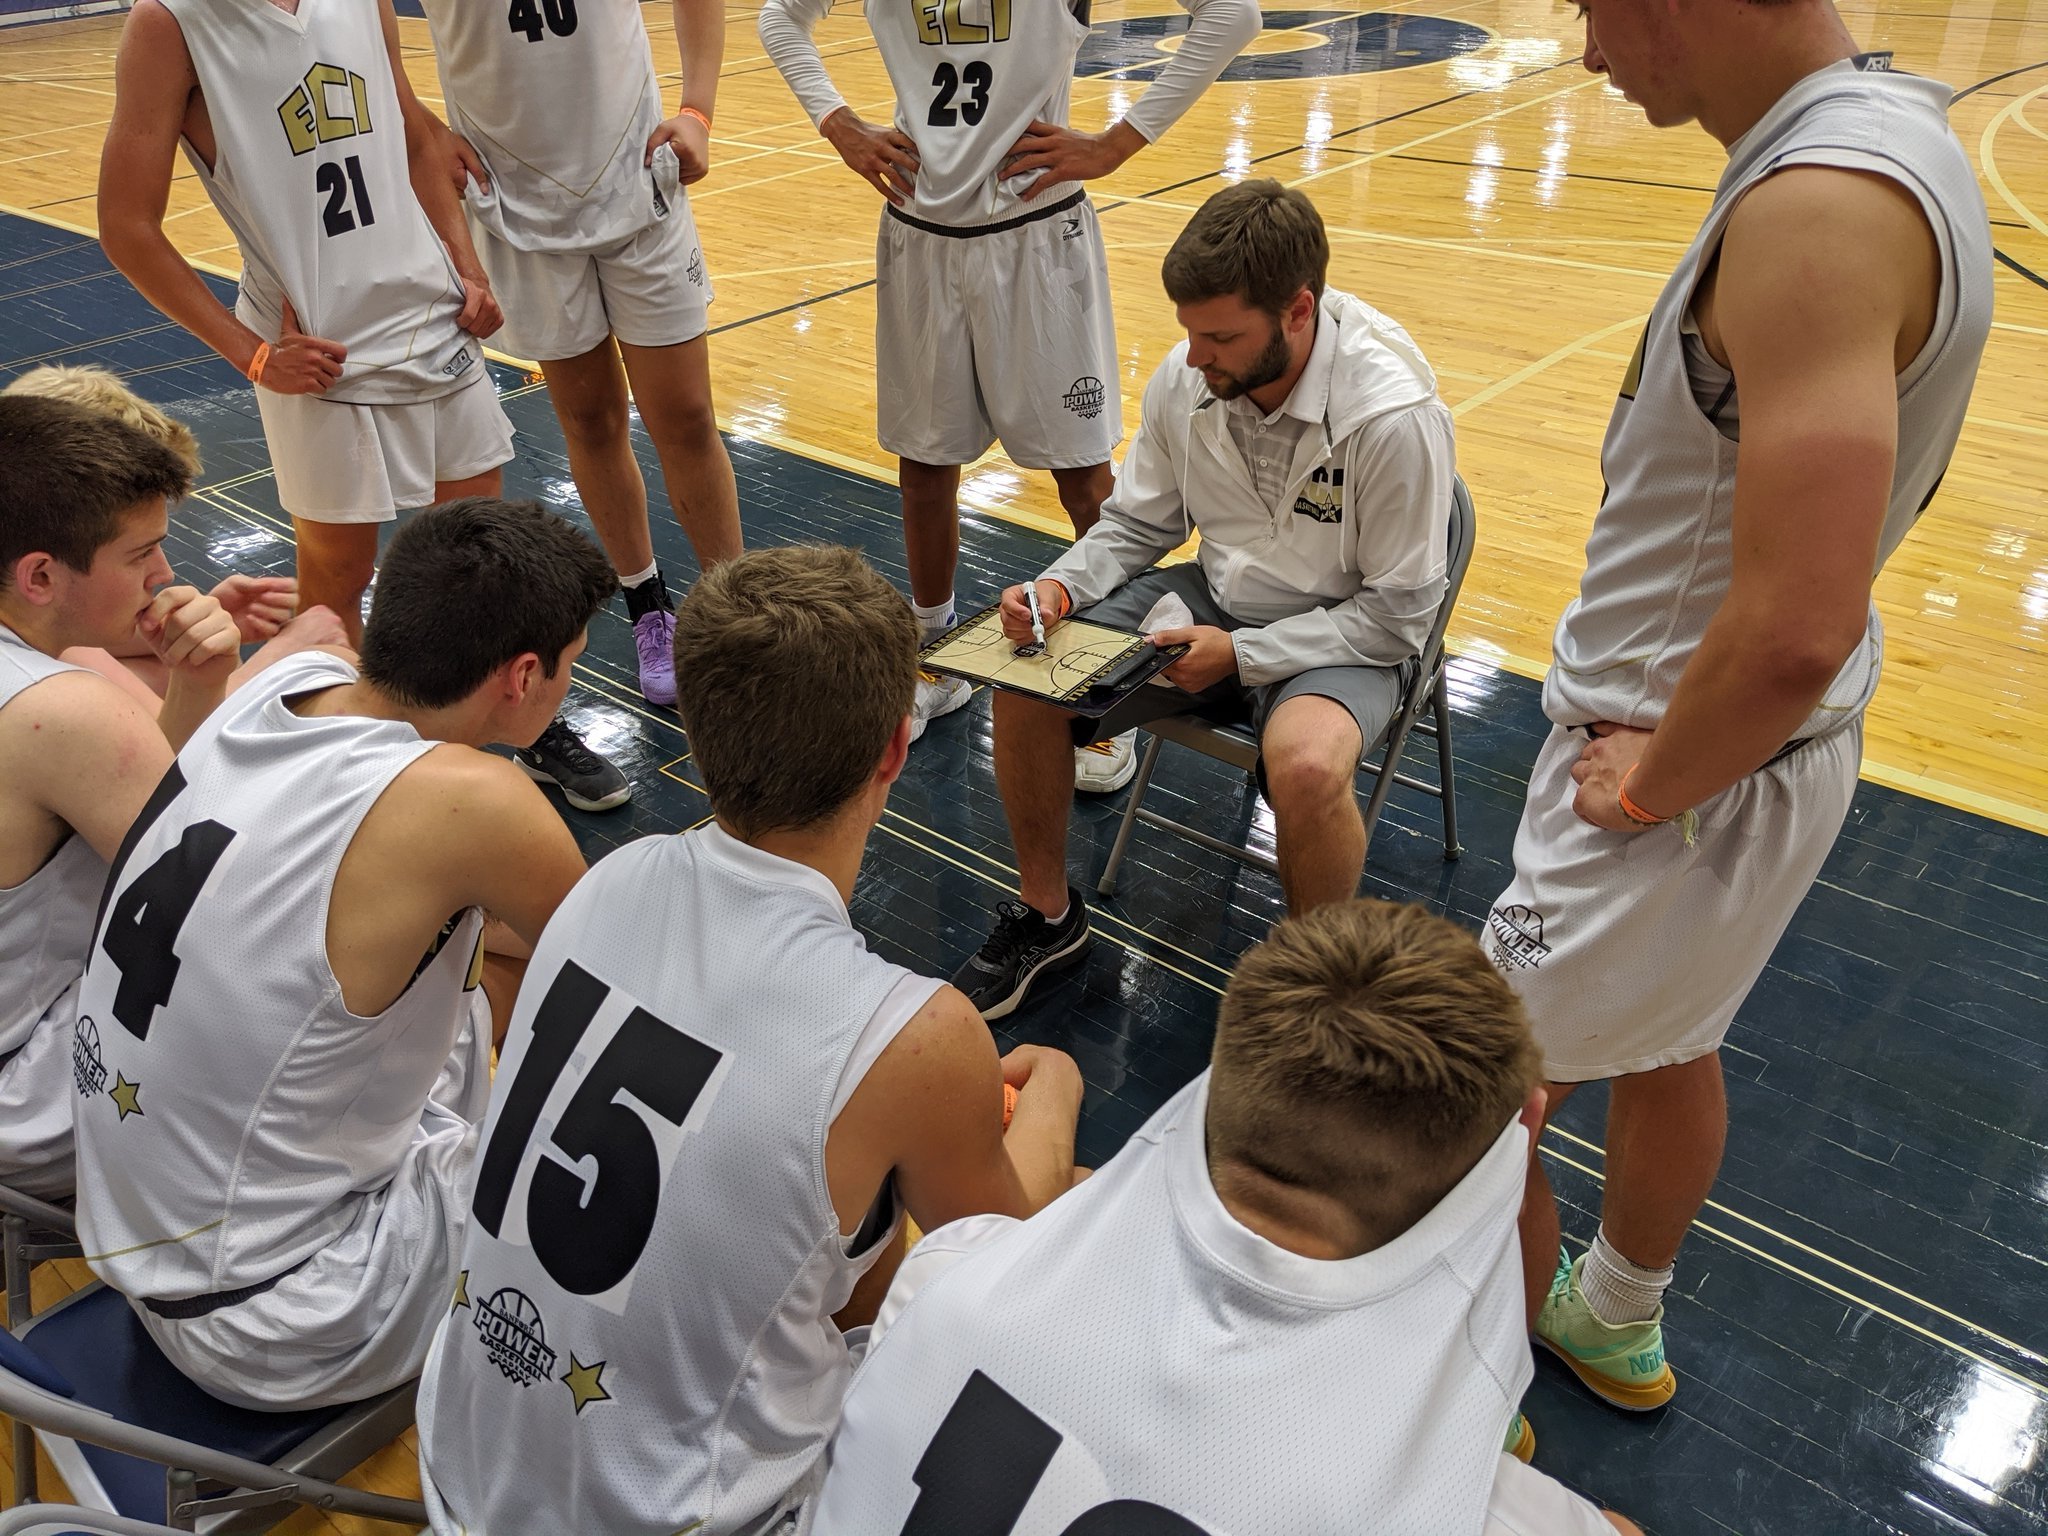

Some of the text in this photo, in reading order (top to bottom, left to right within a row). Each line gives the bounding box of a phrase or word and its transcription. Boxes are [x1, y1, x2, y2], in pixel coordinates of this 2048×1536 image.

[277, 62, 374, 157] ECI
[927, 60, 993, 127] 23
[316, 155, 376, 238] 21
[74, 1036, 106, 1093] OWER
[472, 958, 724, 1296] 15
[473, 1301, 556, 1382] POWER
[479, 1333, 542, 1383] BASKETBALL
